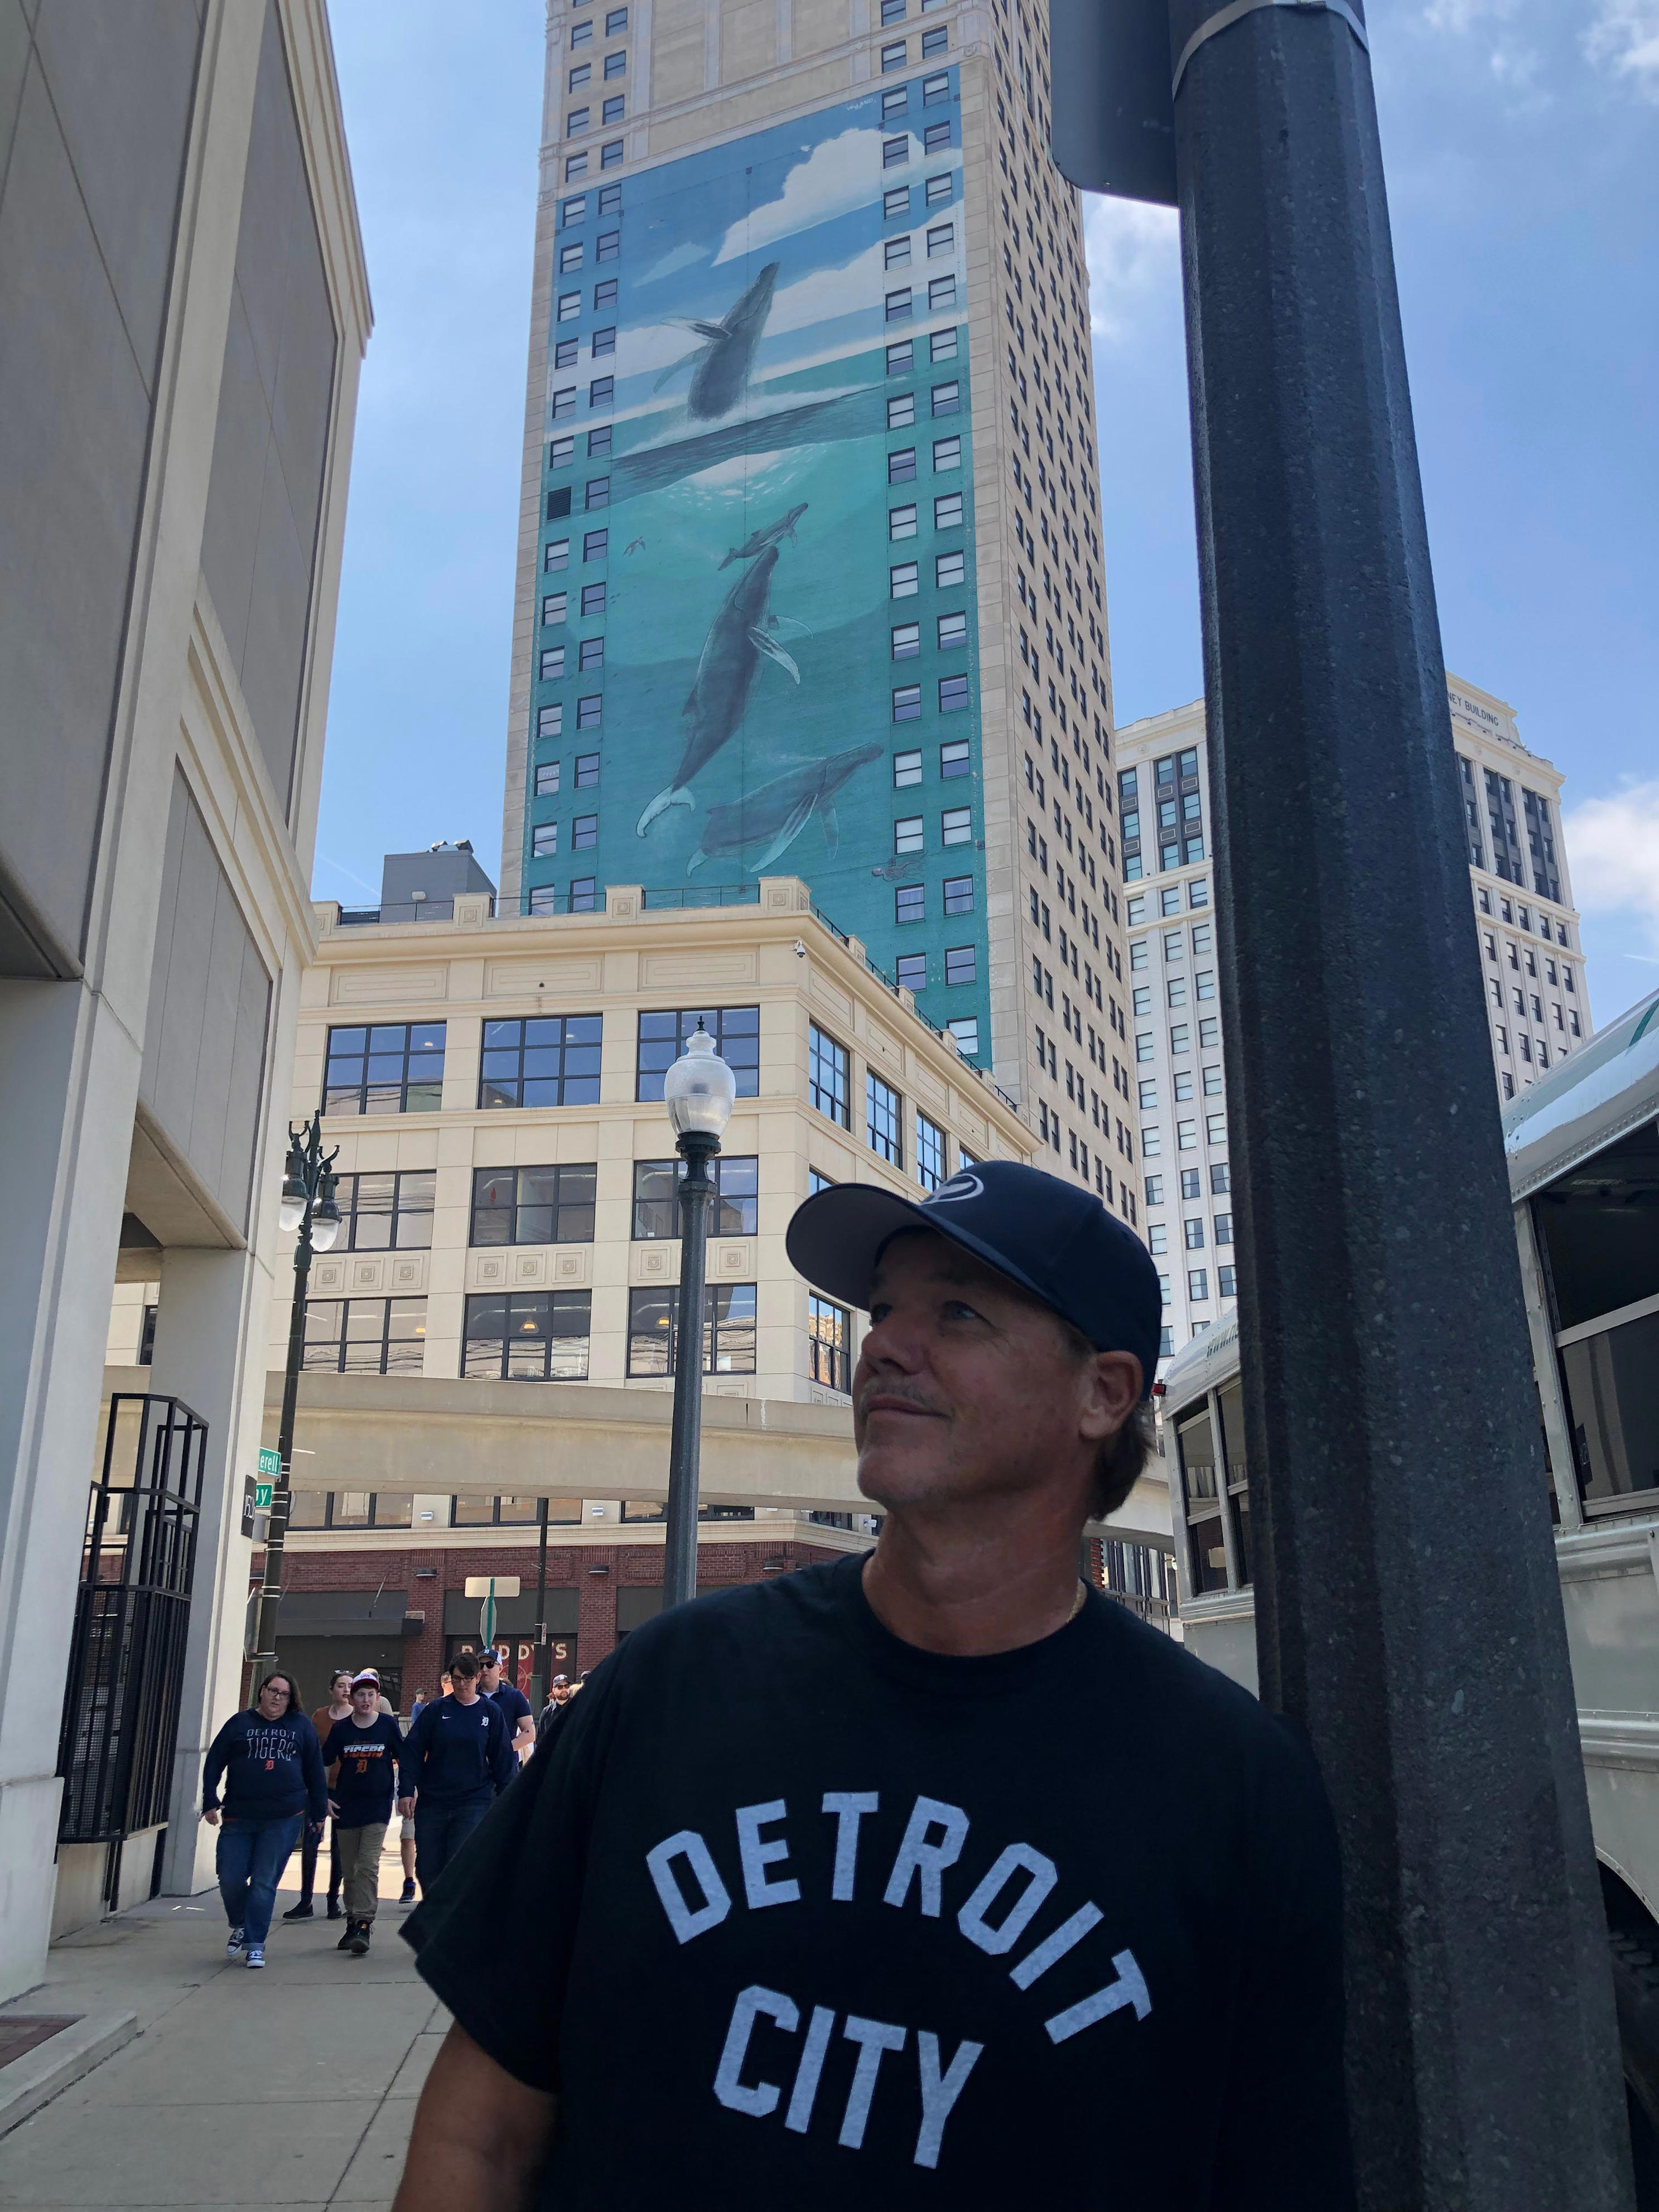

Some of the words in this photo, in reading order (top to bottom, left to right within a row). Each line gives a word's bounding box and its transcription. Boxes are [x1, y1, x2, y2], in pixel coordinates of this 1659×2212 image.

[1464, 700, 1499, 726] BUILDING
[259, 1455, 278, 1472] erell
[645, 1791, 1152, 2045] DETROIT
[712, 1984, 985, 2169] CITY
